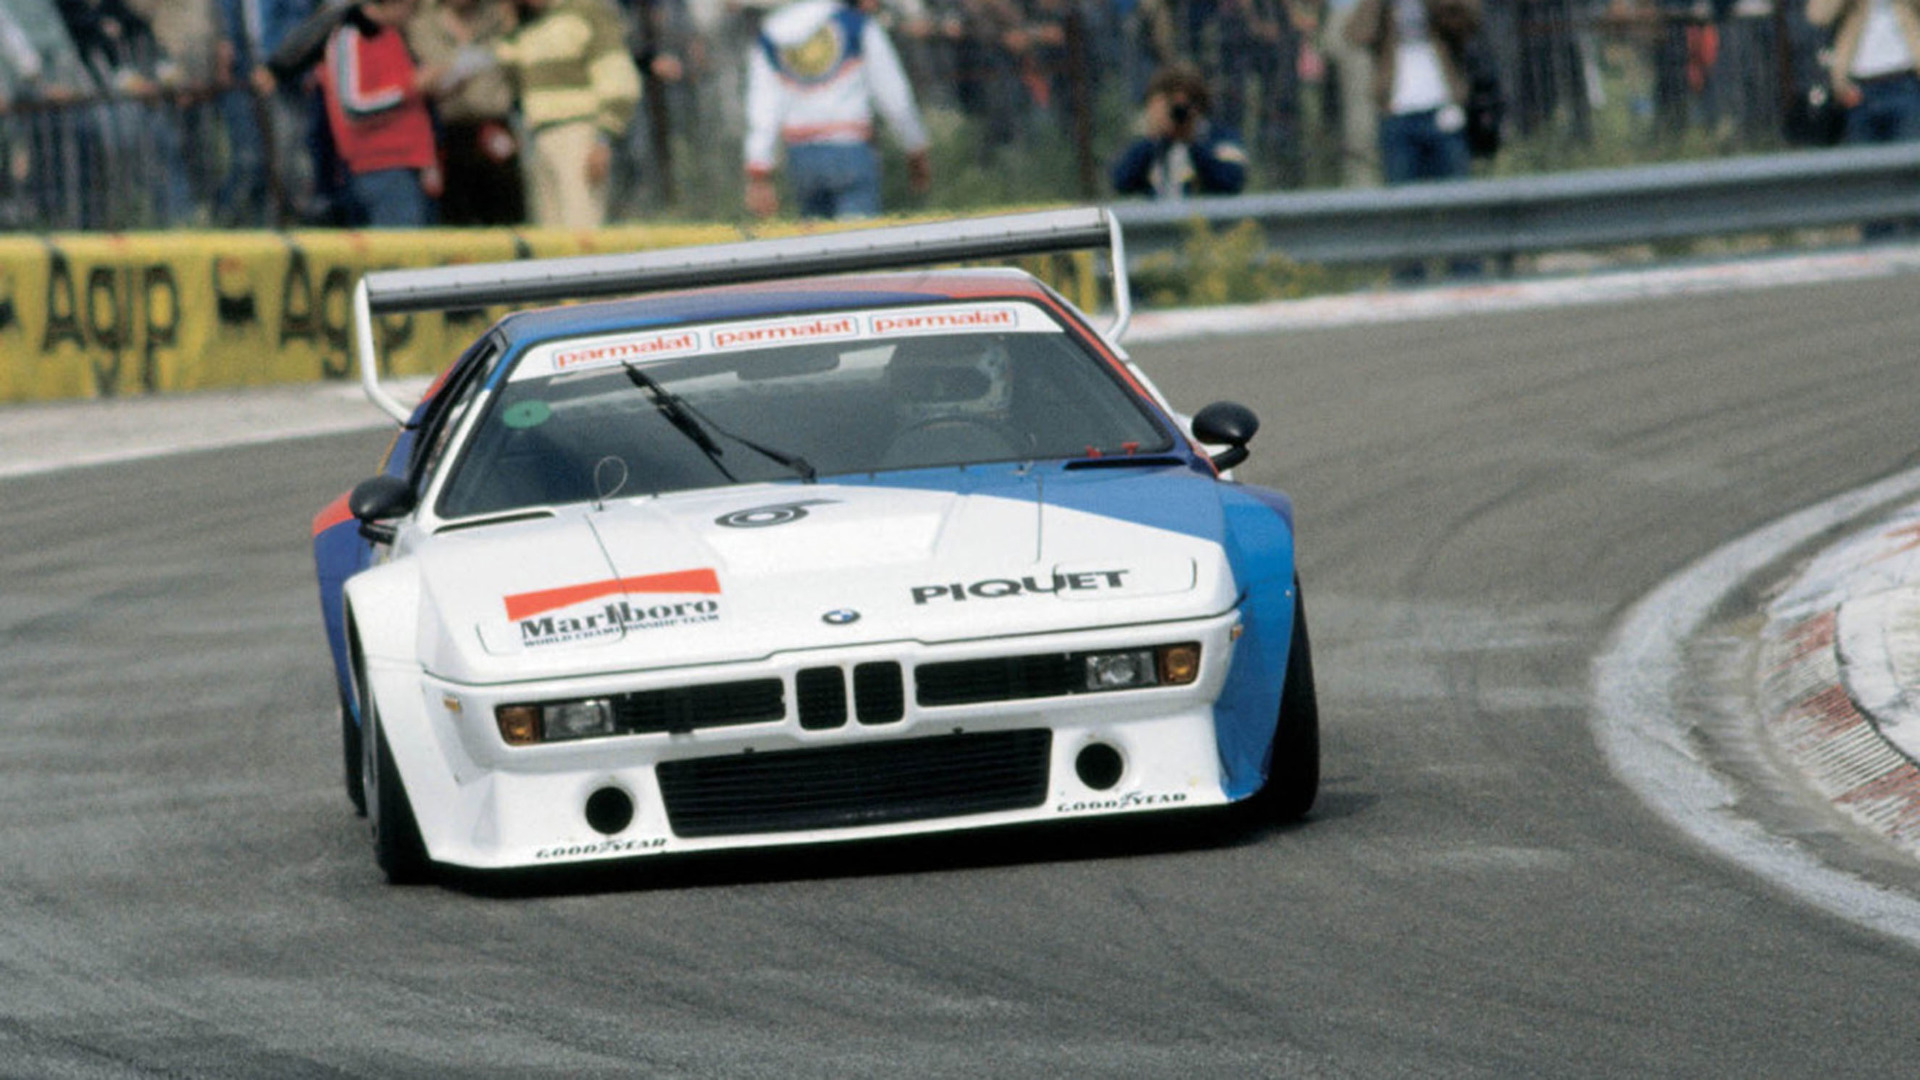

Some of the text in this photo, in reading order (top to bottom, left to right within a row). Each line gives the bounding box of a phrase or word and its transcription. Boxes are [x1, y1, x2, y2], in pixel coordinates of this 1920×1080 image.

[42, 247, 181, 395] Agip
[556, 310, 1012, 367] parmalat parmalat parmalat
[911, 569, 1129, 605] PIQUET
[520, 599, 719, 640] Marlboro
[524, 633, 572, 648] WORLD
[681, 613, 720, 625] TEAM
